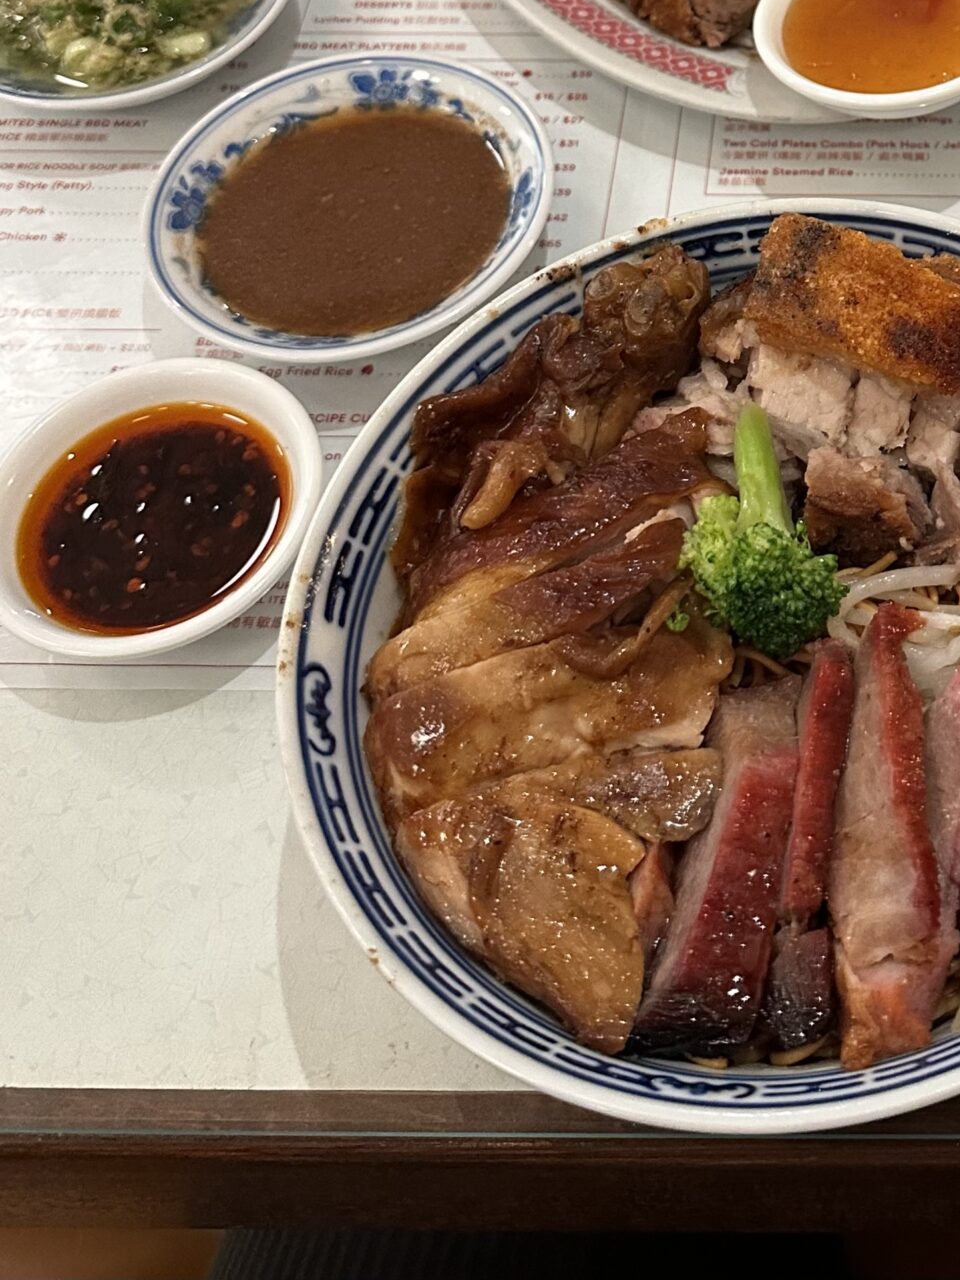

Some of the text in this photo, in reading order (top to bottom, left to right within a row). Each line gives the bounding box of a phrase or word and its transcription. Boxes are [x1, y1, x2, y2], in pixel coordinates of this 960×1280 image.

[354, 1, 412, 9] DESSERTS
[314, 16, 350, 25] Lychee
[355, 16, 400, 25] Pudding
[320, 42, 354, 50] MEAT
[357, 42, 416, 51] PLATTERS
[722, 140, 747, 148] Two
[750, 139, 778, 148] Cold
[781, 139, 817, 148] Plates
[820, 140, 863, 148] Combo
[866, 139, 896, 149] (Pork
[719, 167, 853, 176] Jasmine Steamed Rice
[17, 180, 48, 191] Style
[52, 180, 93, 191] (Fatty)
[19, 206, 46, 215] Pork
[286, 366, 321, 376] Fried
[325, 366, 353, 376] Rice
[324, 452, 342, 460] on
